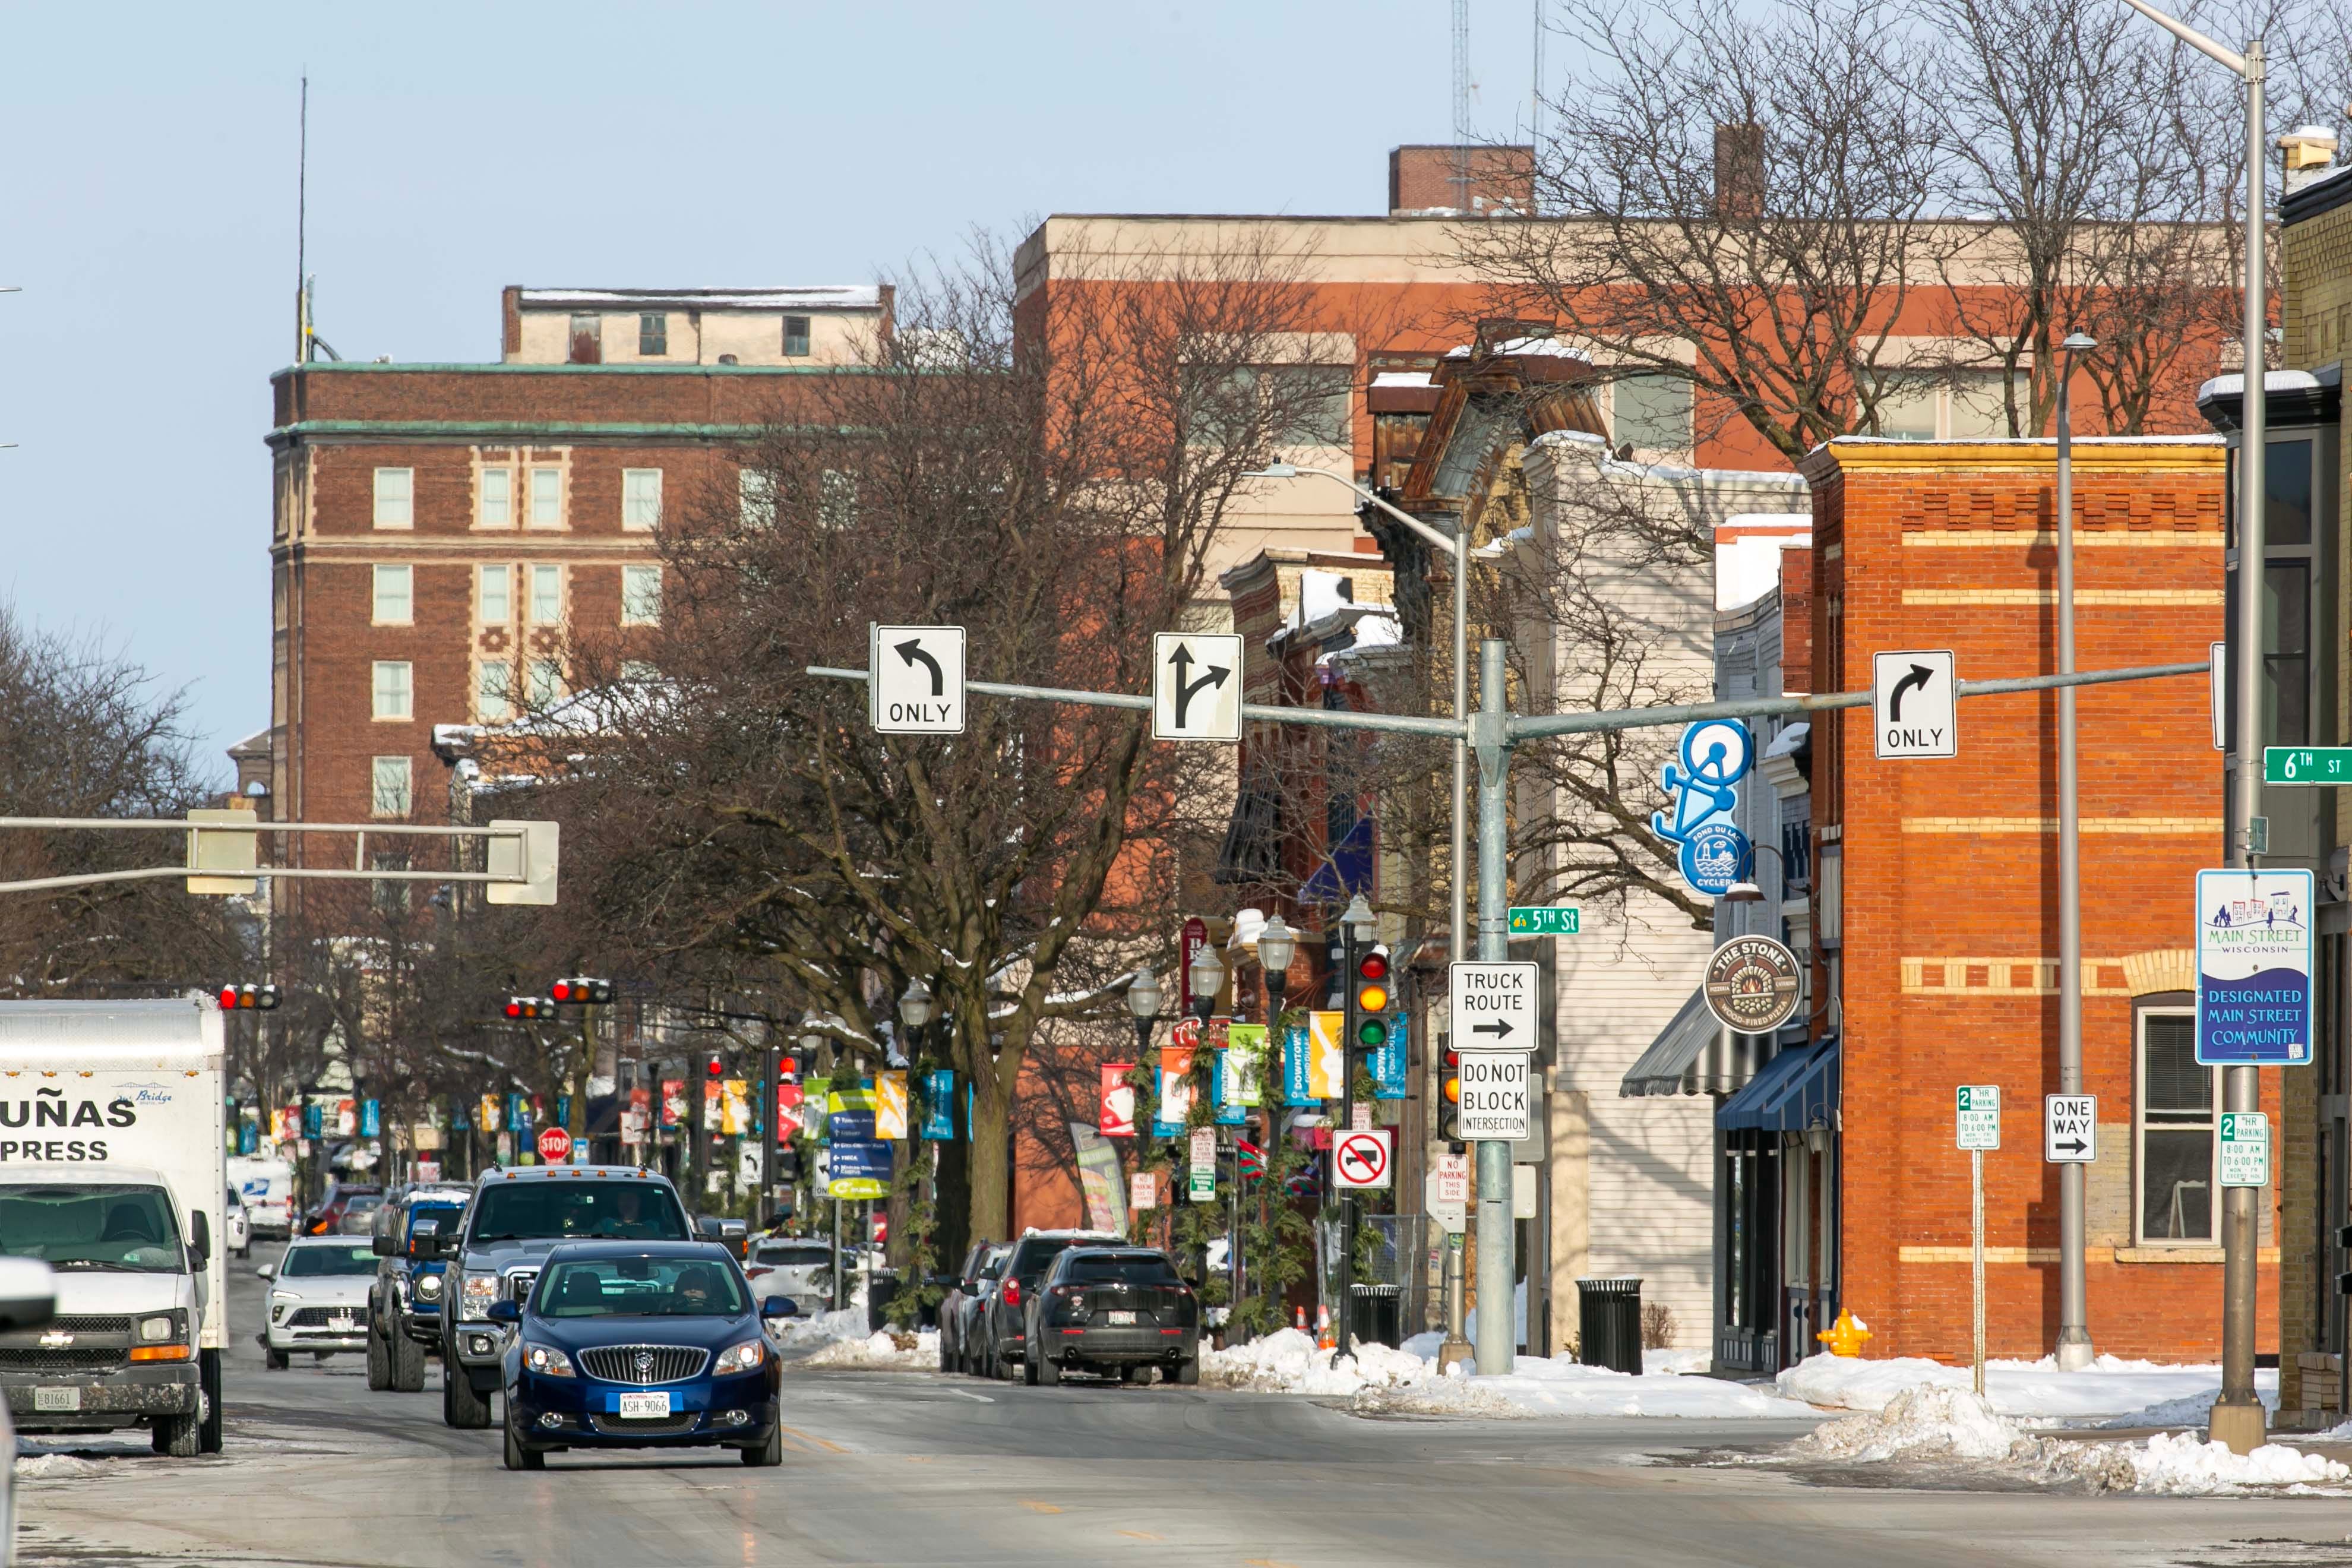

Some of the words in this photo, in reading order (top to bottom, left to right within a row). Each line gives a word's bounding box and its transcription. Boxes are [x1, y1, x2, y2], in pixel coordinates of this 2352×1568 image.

[890, 703, 951, 722] ONLY
[1888, 728, 1943, 748] ONLY
[2284, 753, 2313, 779] 6TH
[2328, 760, 2341, 773] ST
[1693, 827, 1713, 842] FOND
[1727, 829, 1741, 842] LAC
[1697, 878, 1737, 886] CYCLERY
[1533, 910, 1555, 931] 5TH
[1561, 911, 1576, 931] St
[2209, 930, 2243, 944] MAIN
[2248, 930, 2302, 945] STREET
[1715, 946, 1741, 970] THE
[1741, 942, 1785, 966] STONE
[1464, 973, 1523, 989] TRUCK
[1465, 995, 1522, 1010] ROUTE
[2209, 991, 2302, 1003] DESIGNATED
[1721, 1003, 1768, 1026] WOOD-FIRED
[1768, 1001, 1787, 1021] PIZZA
[2208, 1010, 2243, 1023] MAIN
[2247, 1009, 2302, 1025] STREET
[2211, 1028, 2298, 1045] COMMUNITY
[1389, 1040, 1396, 1051] DU
[1465, 1064, 1487, 1082] DO
[1491, 1064, 1525, 1082] NOT
[135, 1090, 172, 1104] Bridge
[1464, 1092, 1525, 1110] BLOCK
[1960, 1090, 1969, 1106] 2
[1972, 1099, 1996, 1107] PARKING
[0, 1087, 137, 1128] UÑAS
[2054, 1102, 2089, 1116] ONE
[1463, 1117, 1525, 1130] INTERSECTION
[2053, 1120, 2090, 1134] WAY
[2223, 1118, 2233, 1136] 2
[2236, 1128, 2263, 1137] PARKING
[1, 1140, 108, 1161] PRESS
[542, 1137, 568, 1152] STOP
[2227, 1145, 2243, 1153] 8:00
[2249, 1145, 2261, 1153] AM
[1447, 1161, 1459, 1169] NO
[2224, 1156, 2231, 1165] TO
[2234, 1157, 2250, 1165] 6:00
[2254, 1157, 2264, 1165] PM
[1439, 1171, 1466, 1180] PARKING
[45, 1393, 70, 1405] 81661
[623, 1401, 667, 1412] ASH-9066
